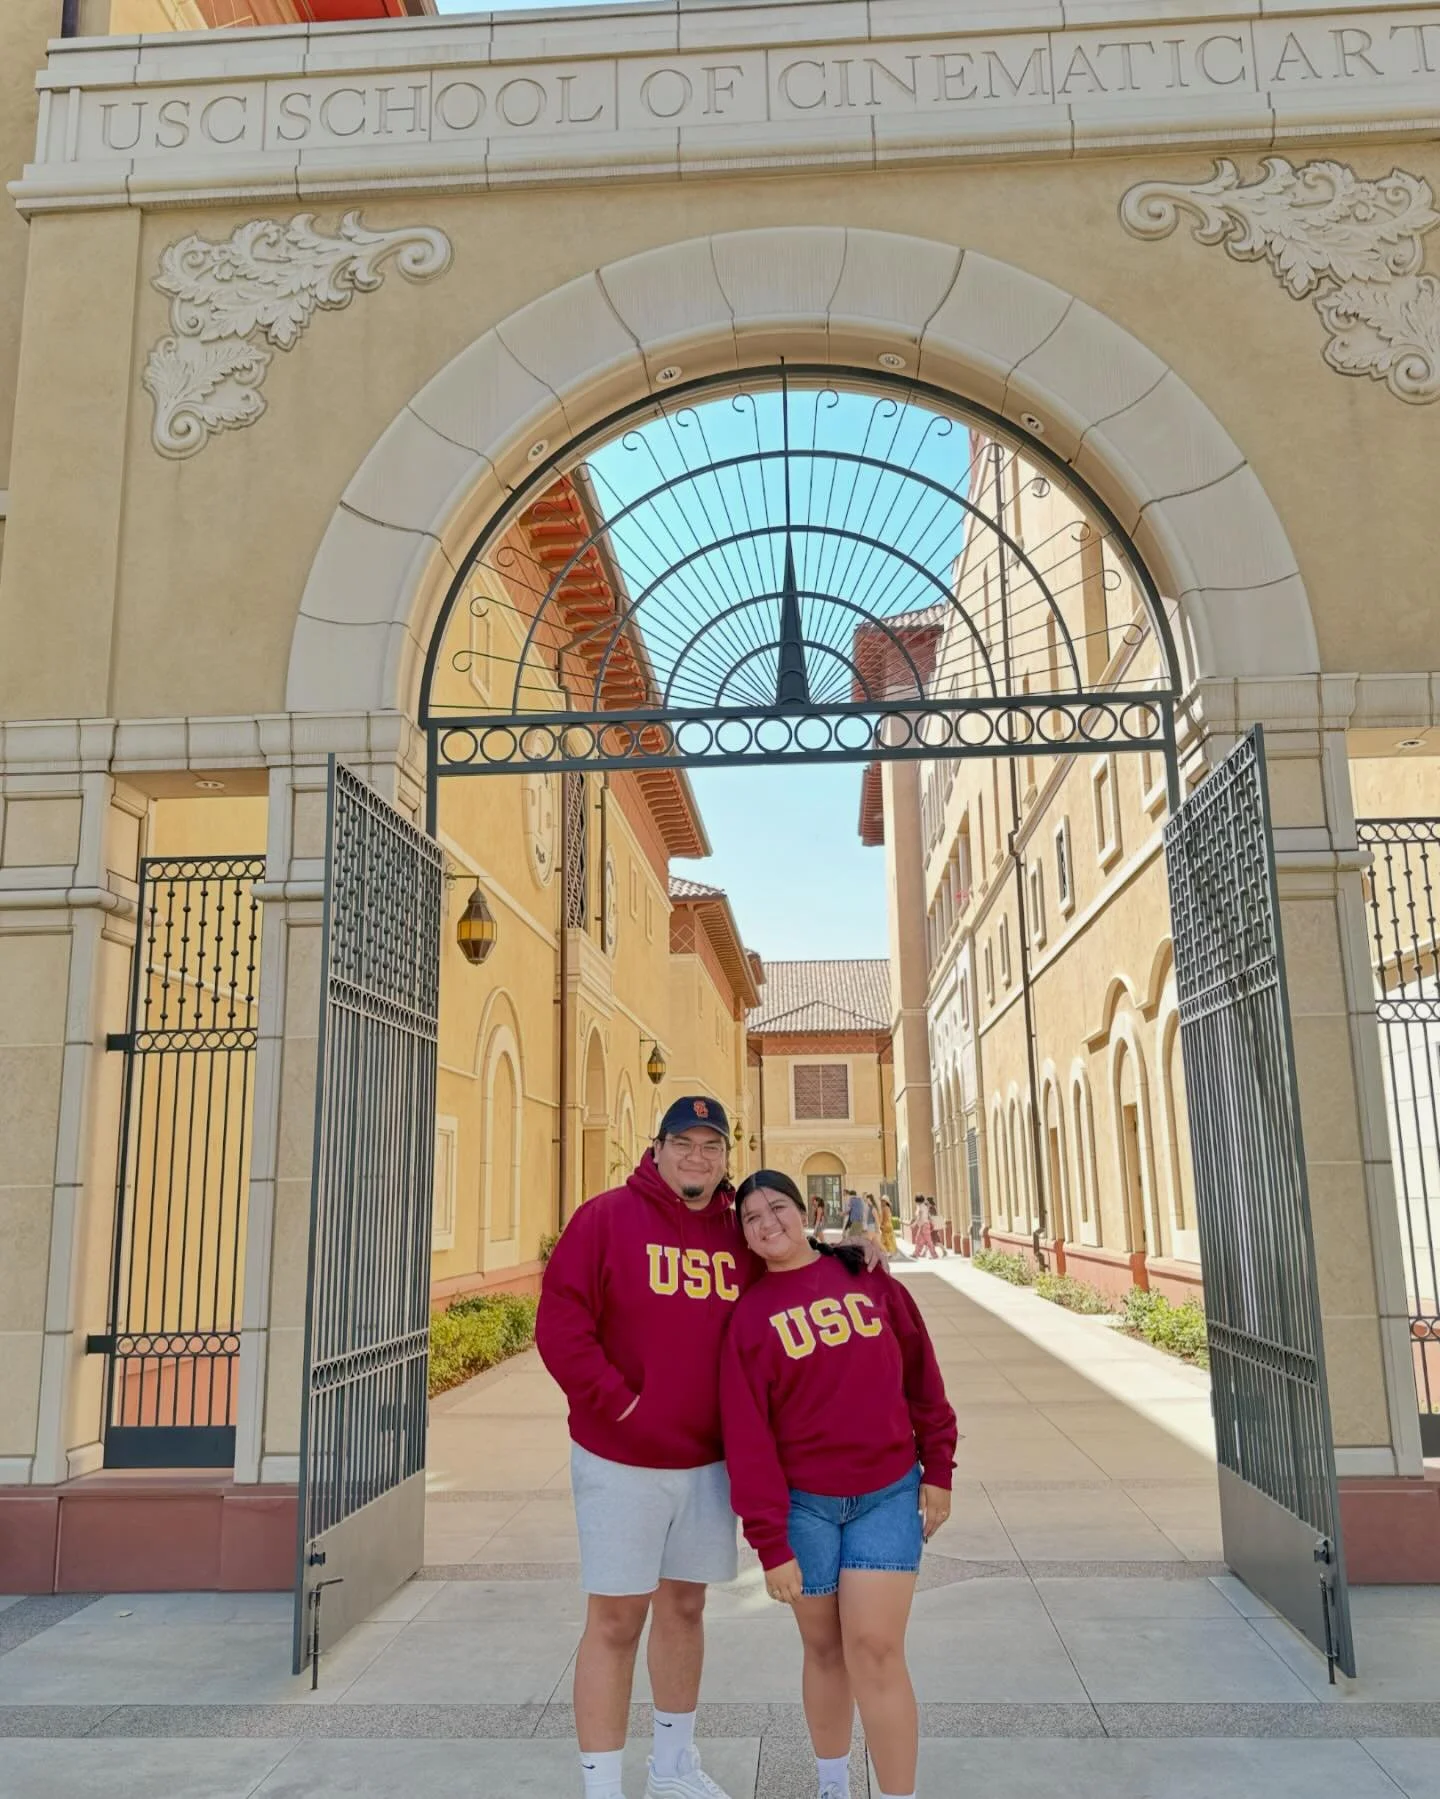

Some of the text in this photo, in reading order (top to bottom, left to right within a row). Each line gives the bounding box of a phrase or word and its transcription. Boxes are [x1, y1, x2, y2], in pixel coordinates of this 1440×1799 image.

[101, 23, 1440, 151] USC SCHOOL OF CINEMATIC ART
[646, 1243, 741, 1302] USC
[769, 1292, 883, 1360] USC
